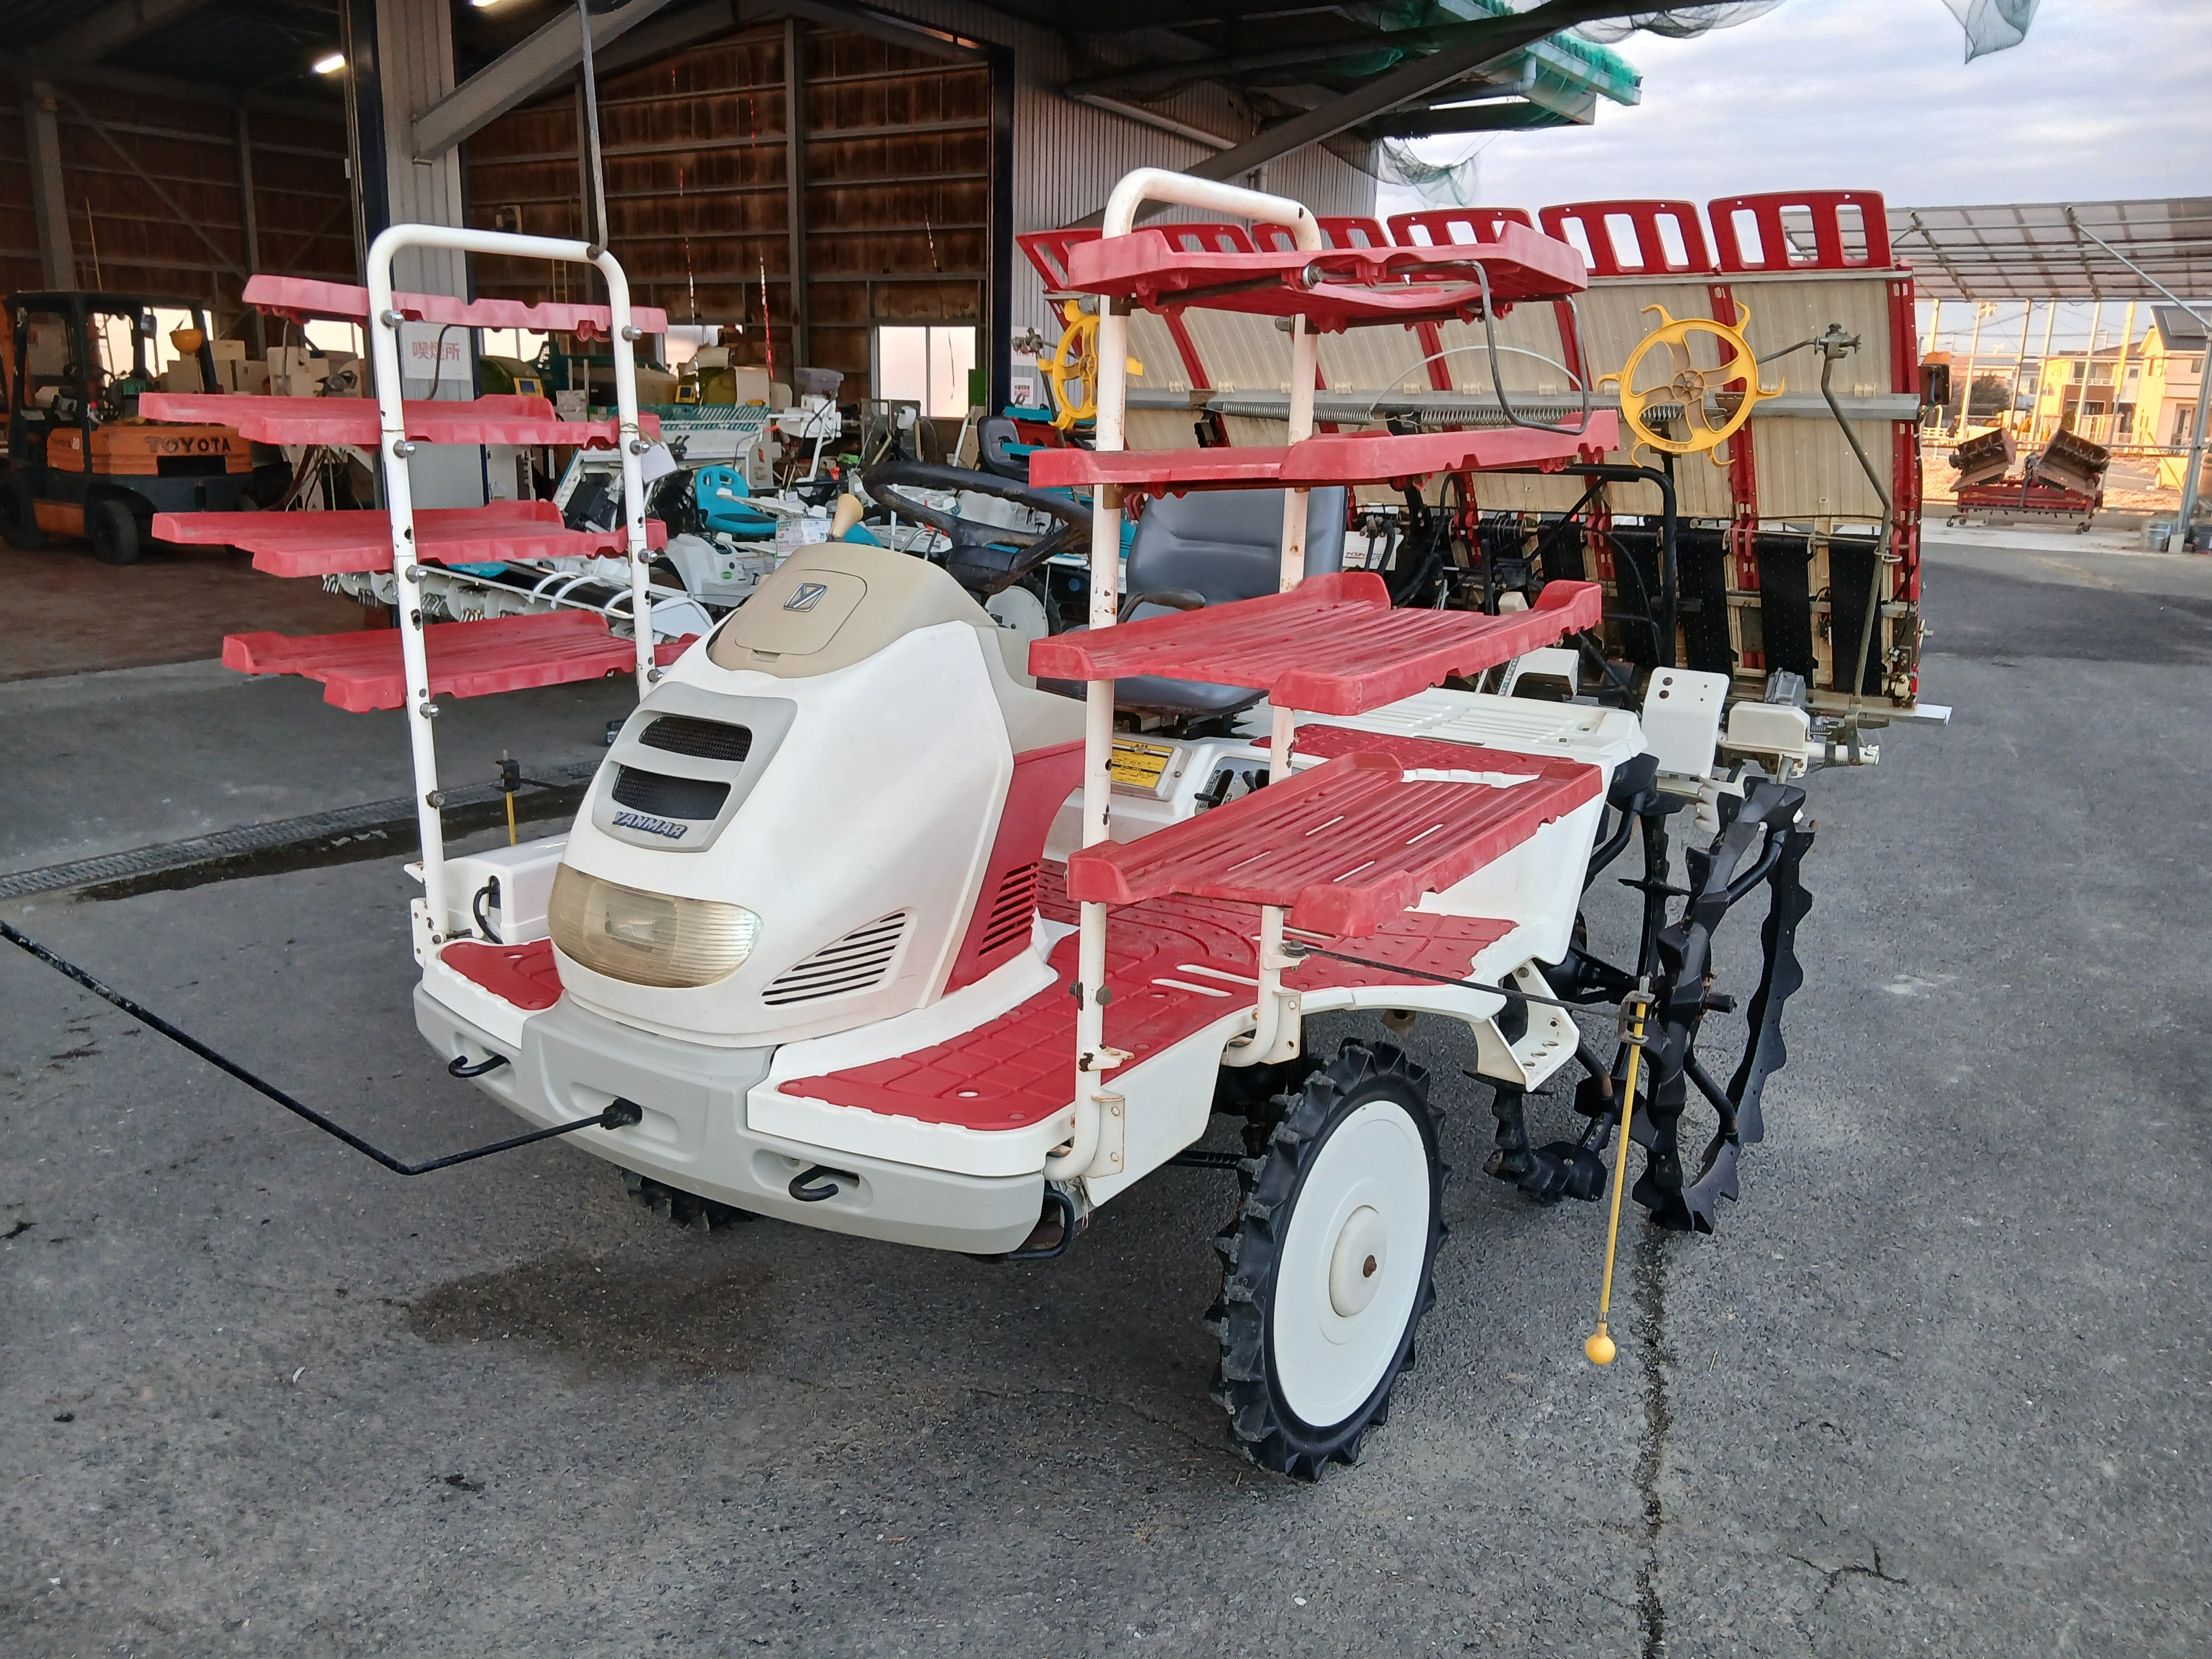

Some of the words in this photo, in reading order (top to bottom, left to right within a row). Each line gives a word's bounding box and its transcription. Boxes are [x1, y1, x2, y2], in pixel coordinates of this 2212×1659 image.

[412, 341, 460, 361] 喫煙所
[145, 436, 232, 452] TOYOTA
[612, 811, 687, 839] YANMAR
